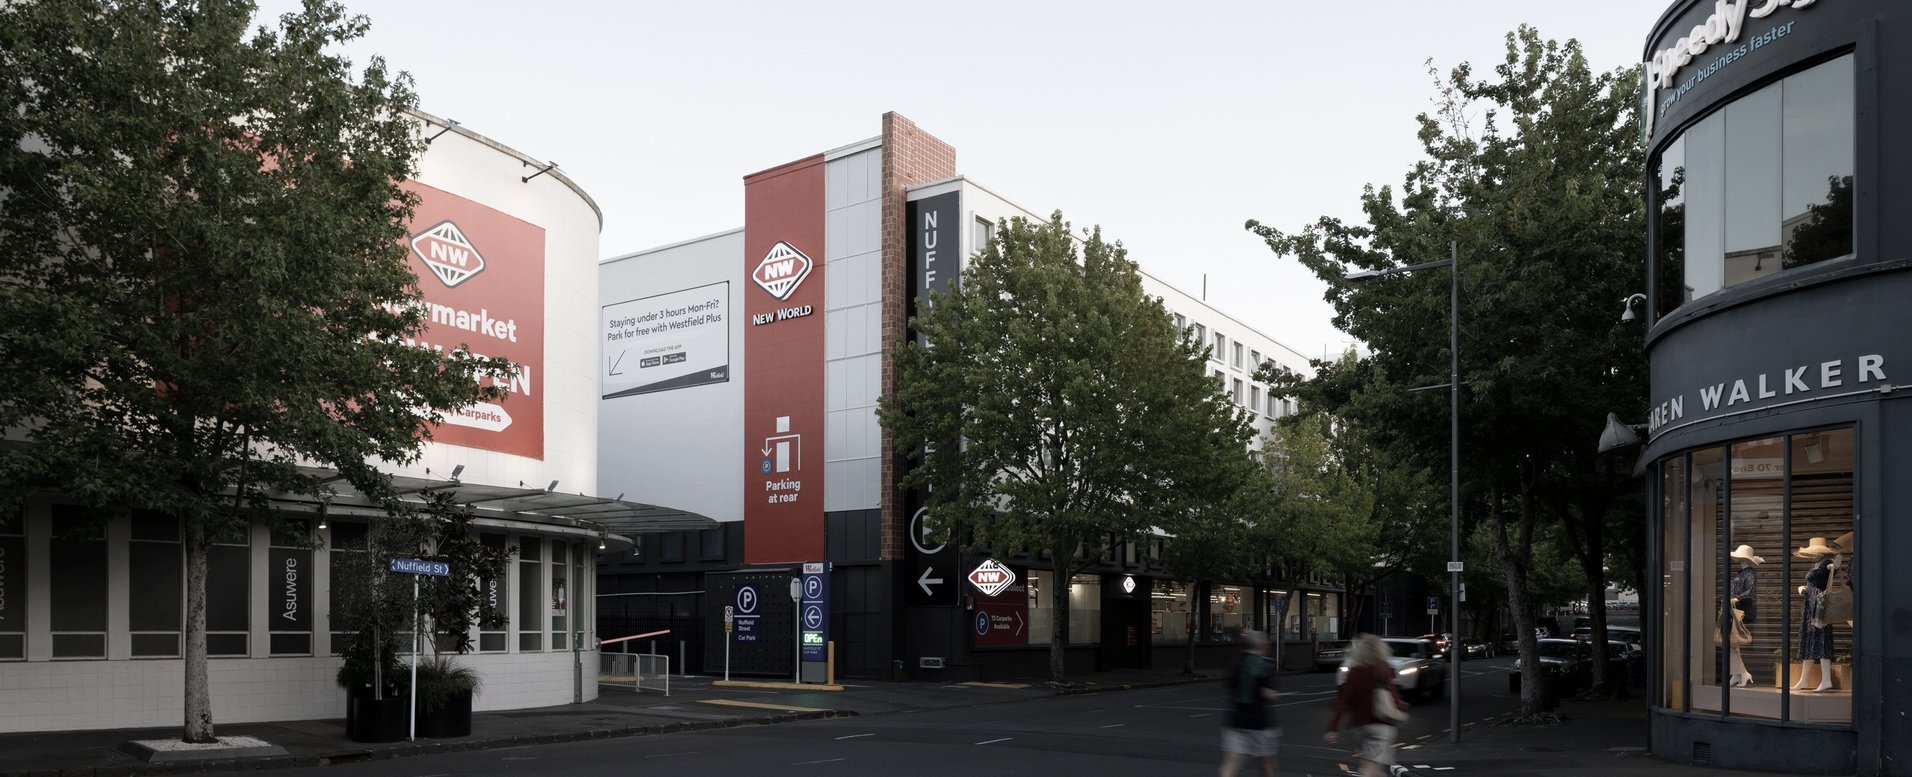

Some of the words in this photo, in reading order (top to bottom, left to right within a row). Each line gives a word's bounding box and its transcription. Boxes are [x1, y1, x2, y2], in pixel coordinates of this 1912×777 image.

[1661, 91, 1676, 116] grow
[1676, 76, 1696, 101] your
[1698, 44, 1747, 82] business
[1750, 20, 1795, 50] faster
[431, 241, 469, 267] NW
[764, 259, 795, 280] NW
[609, 316, 636, 329] Staying
[637, 312, 658, 323] under
[660, 310, 664, 319] 3
[665, 308, 686, 318] hours
[688, 299, 720, 313] Mon-Fri?
[753, 312, 774, 326] NEW
[777, 304, 812, 320] WORLD
[607, 331, 623, 341] Park
[624, 329, 634, 339] for
[636, 327, 650, 337] free
[651, 324, 668, 334] with
[669, 315, 704, 330] Westfield
[706, 313, 722, 324] Plus
[1648, 394, 1684, 435] AREN
[1700, 354, 1887, 411] WALKER
[766, 478, 800, 491] Parking
[768, 494, 777, 503] at
[780, 493, 798, 502] rear
[397, 561, 431, 572] Nuffield
[434, 564, 443, 573] St
[977, 572, 1000, 582] NW
[283, 557, 297, 621] Asuwere
